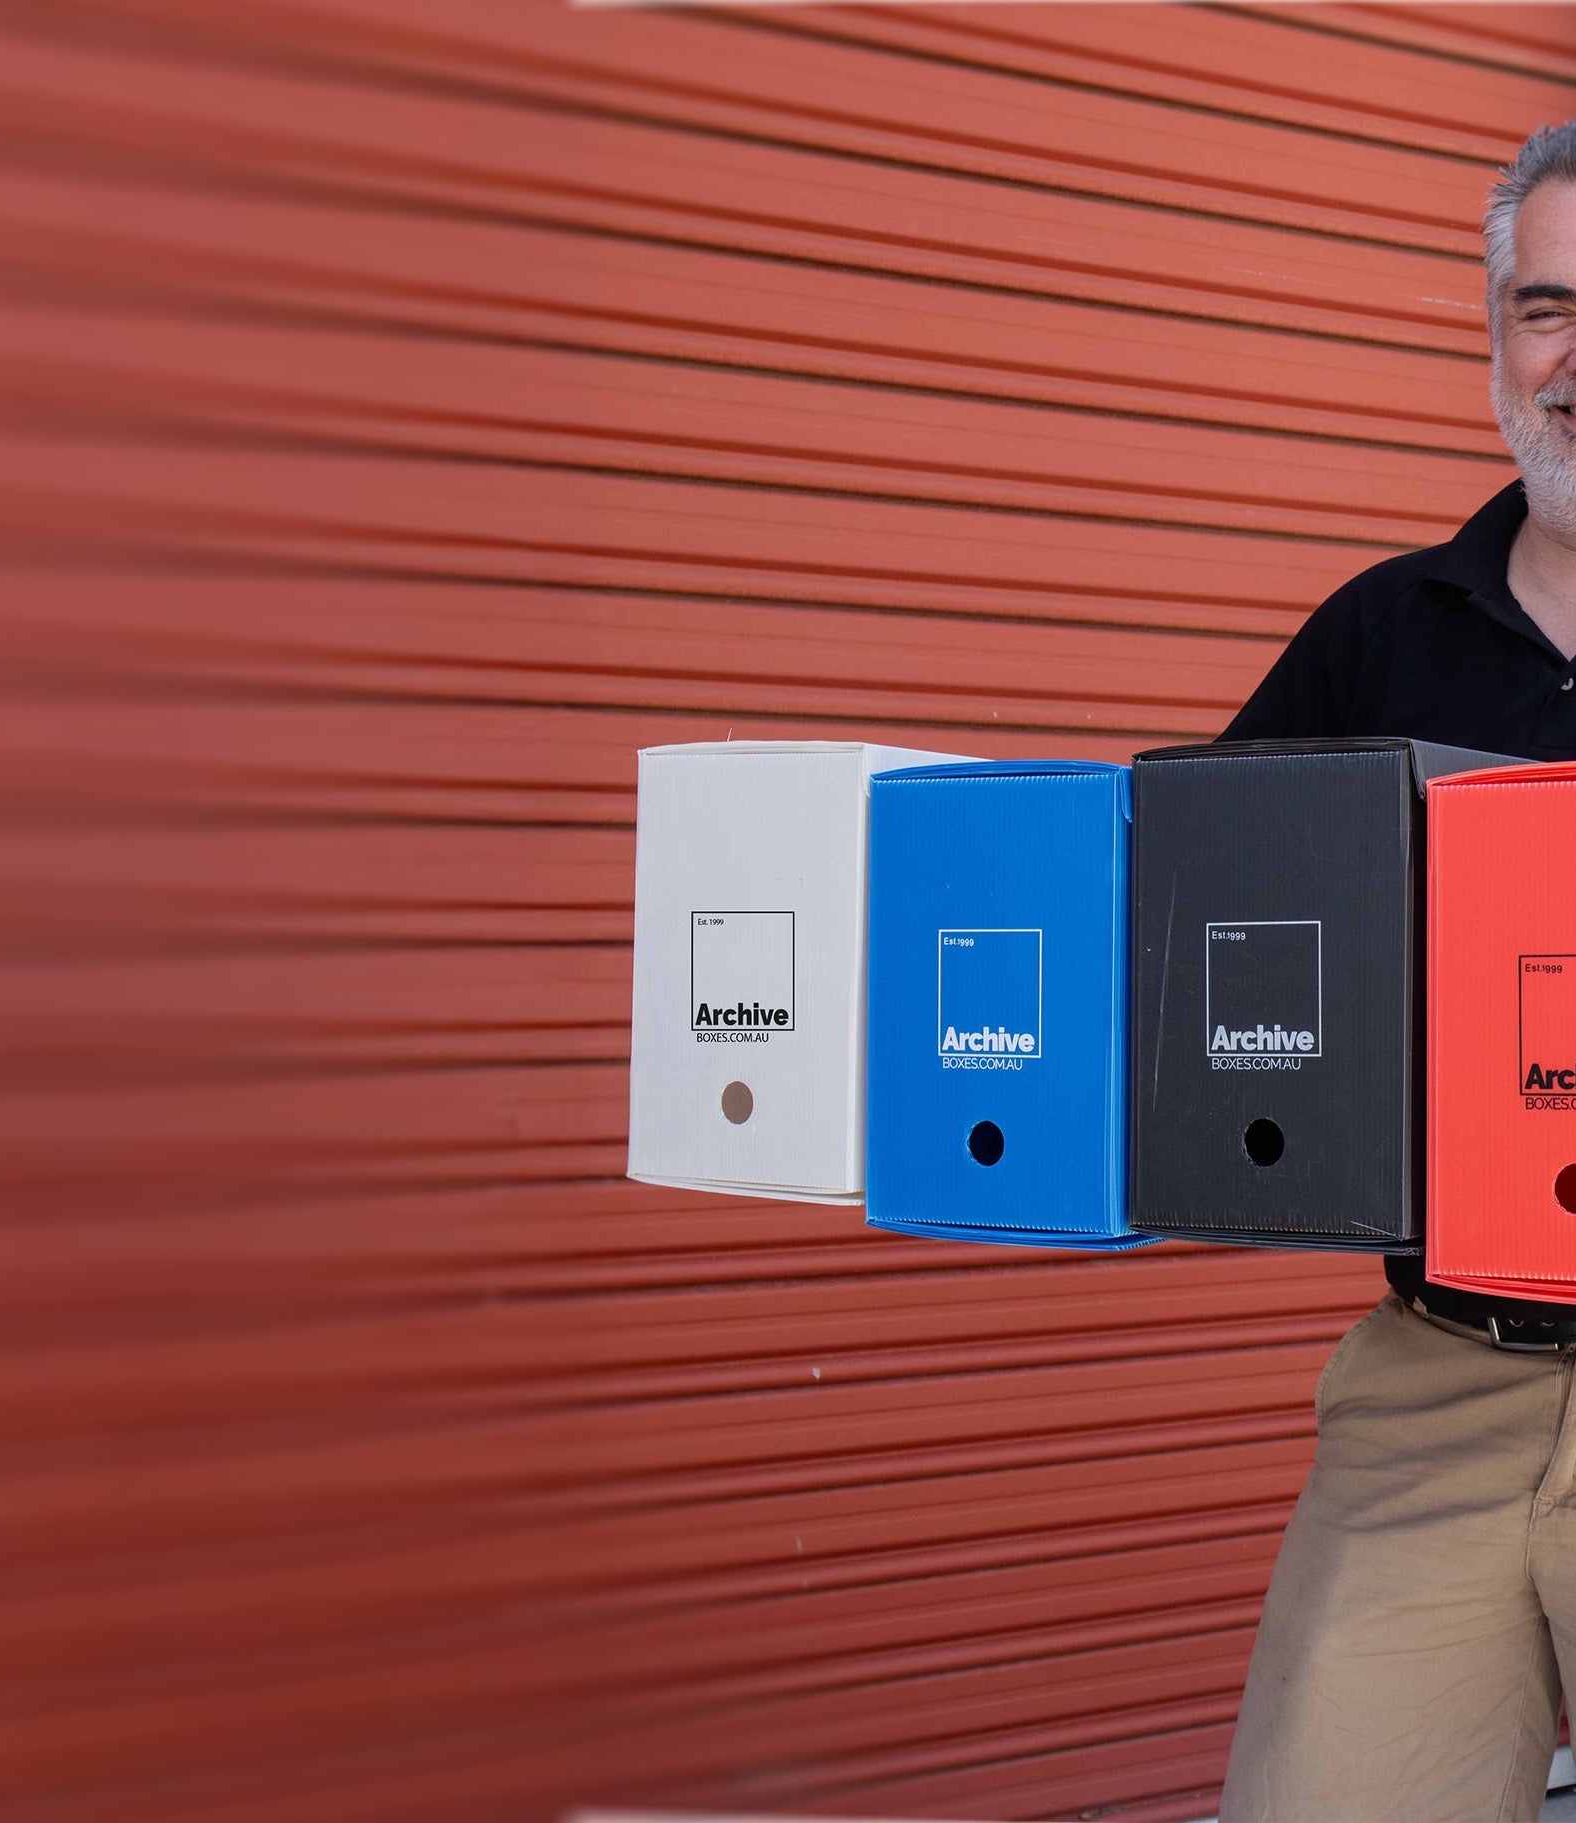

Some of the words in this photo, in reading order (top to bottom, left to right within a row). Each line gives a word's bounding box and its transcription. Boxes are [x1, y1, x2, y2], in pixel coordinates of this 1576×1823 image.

[695, 1002, 789, 1026] Archive
[696, 1032, 769, 1043] BOXES.COM.AU
[942, 1026, 1035, 1053] Archive
[1211, 1024, 1315, 1051] Archive
[942, 1057, 1023, 1071] BOXES.COM.AU
[1211, 1057, 1301, 1070] BOXES.COM.AU
